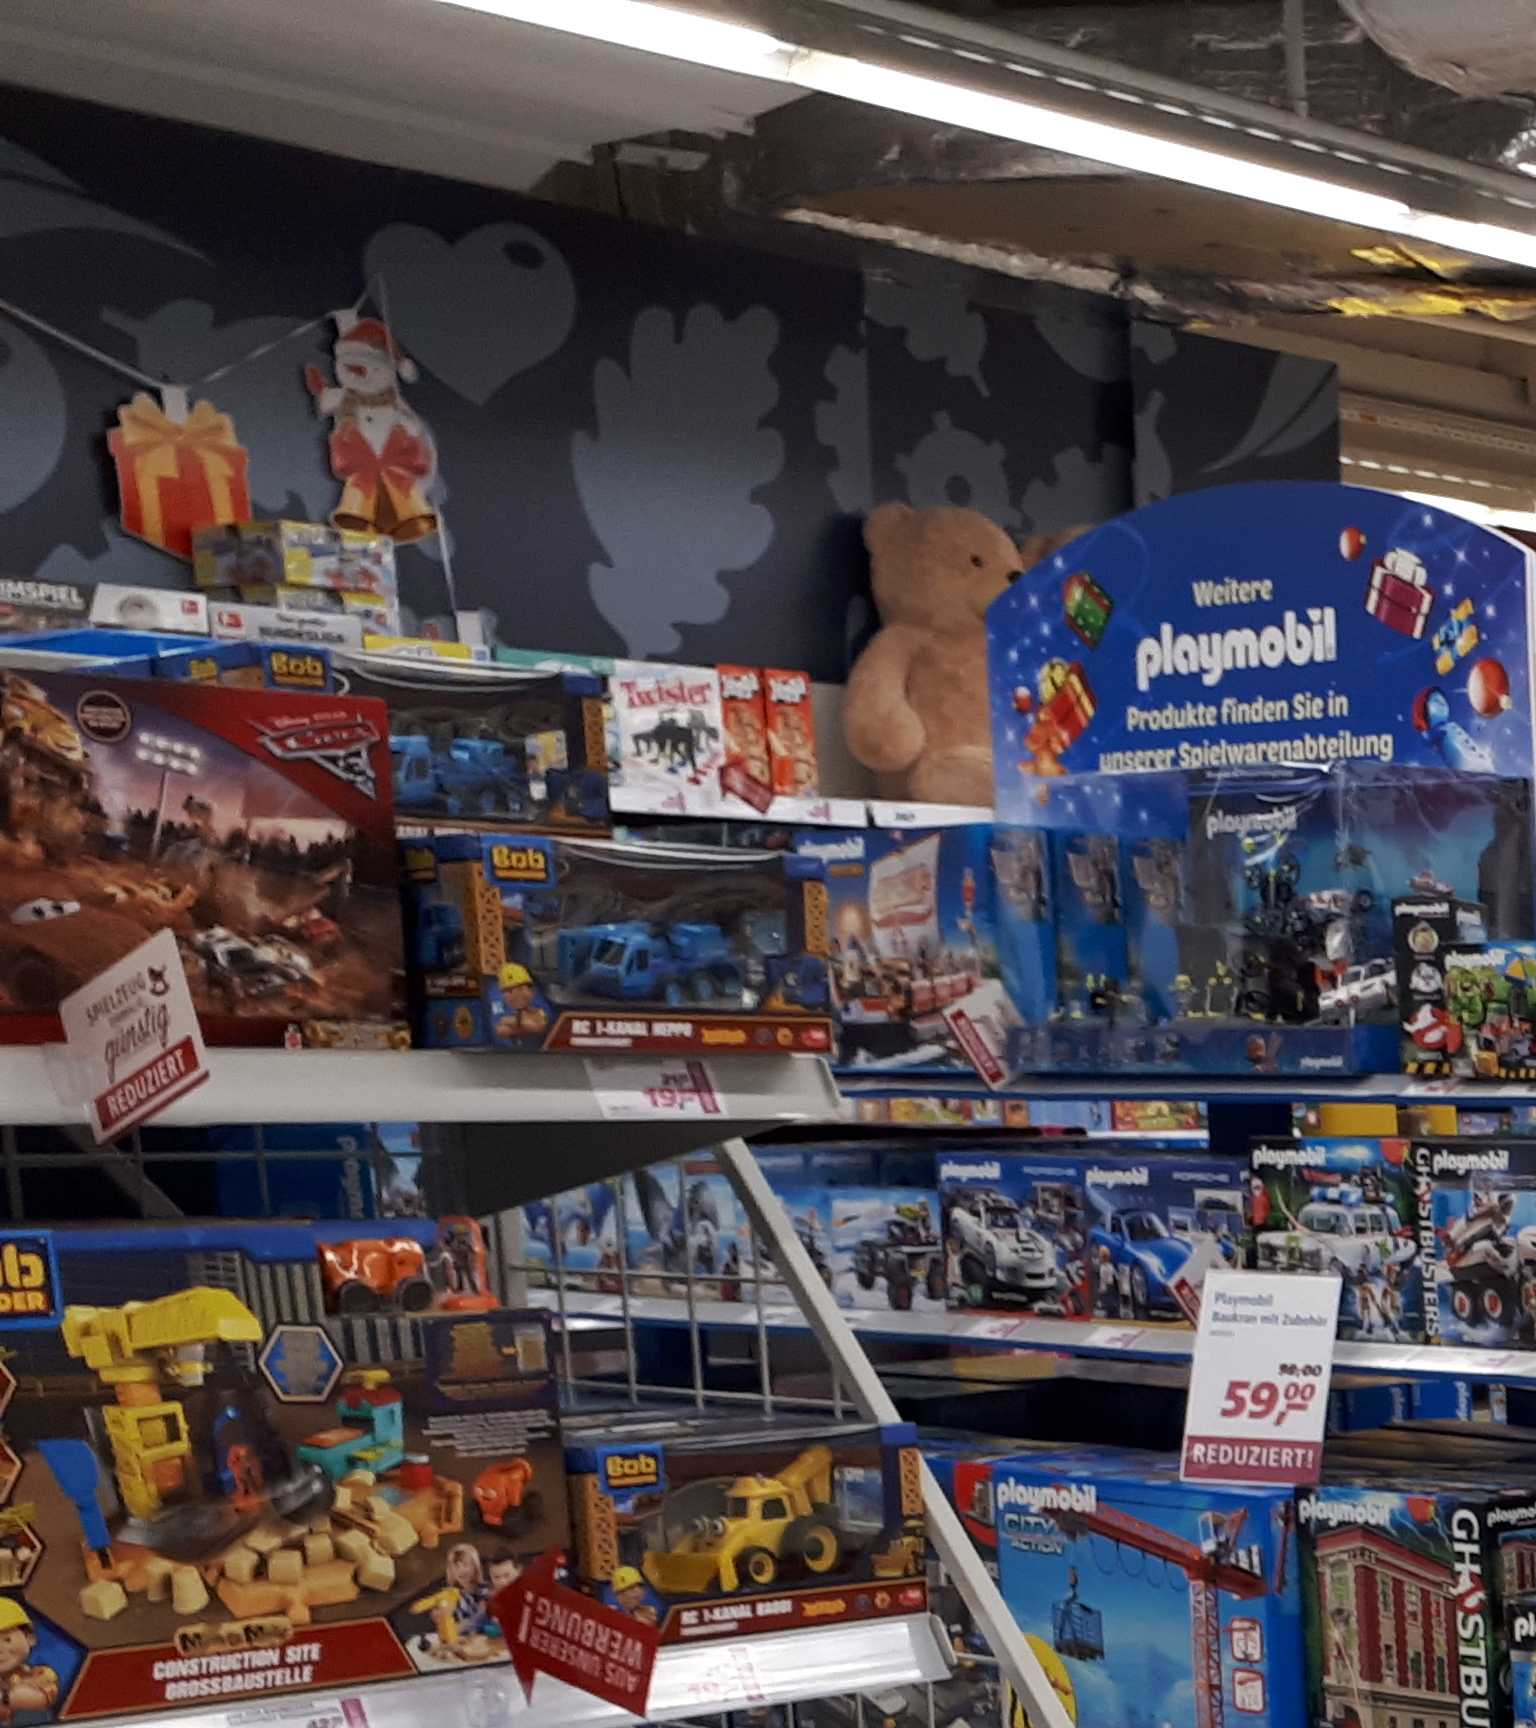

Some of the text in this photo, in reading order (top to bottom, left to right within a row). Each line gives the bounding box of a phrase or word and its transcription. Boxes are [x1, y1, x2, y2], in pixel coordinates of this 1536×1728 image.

[1192, 575, 1273, 608] Weitere
[1135, 606, 1337, 692] playmobil
[620, 680, 712, 709] Twister
[1126, 692, 1349, 733] Produkte finden Sie in
[1100, 745, 1176, 773] unserer
[1178, 731, 1394, 773] Spielwarenabteilung
[1204, 804, 1298, 840] playmobil
[492, 847, 546, 871] Bob
[105, 1046, 187, 1121] REDUZIERT
[1432, 1149, 1510, 1174] playmobil
[606, 1454, 657, 1477] Bob
[1191, 1442, 1315, 1470] REDUZIERT!
[996, 1477, 1097, 1515] playmobil
[1299, 1498, 1390, 1528] playmobil
[152, 1642, 322, 1683] CONSTRUCTION SITE
